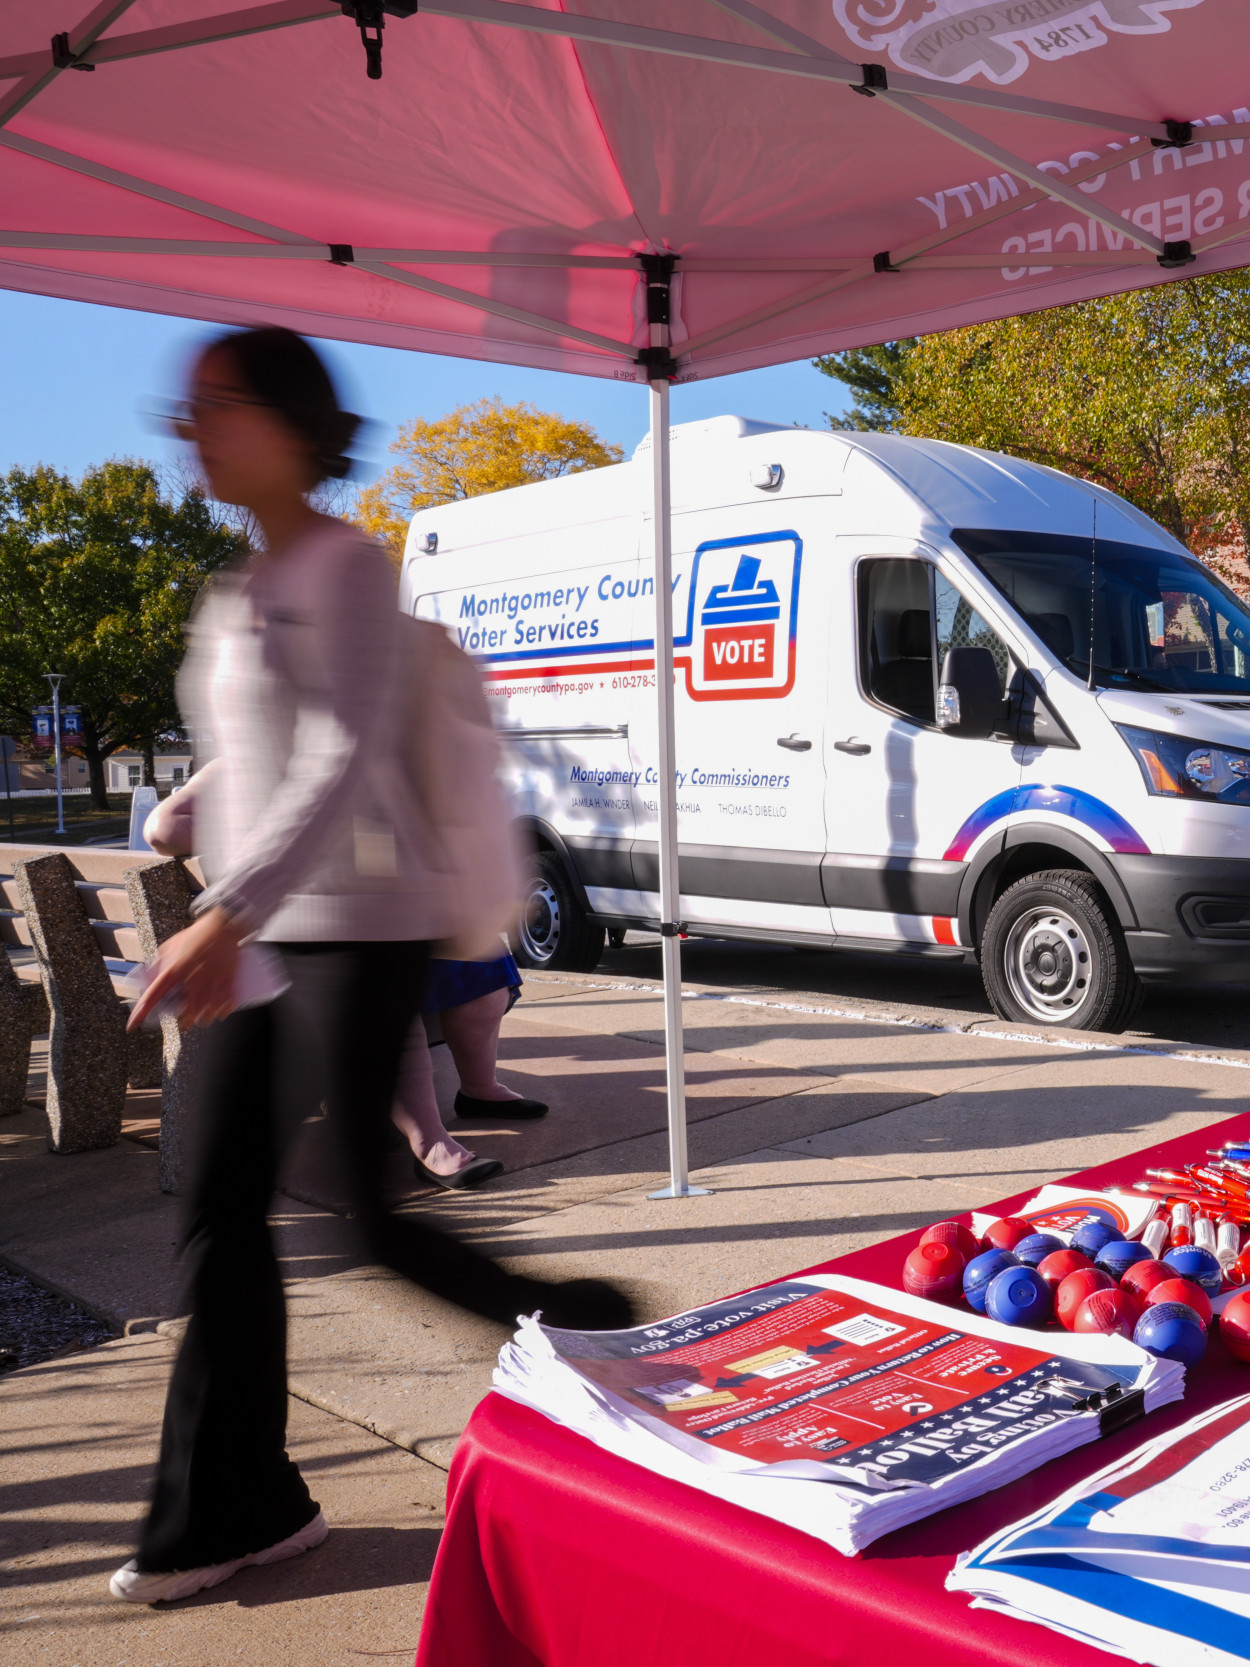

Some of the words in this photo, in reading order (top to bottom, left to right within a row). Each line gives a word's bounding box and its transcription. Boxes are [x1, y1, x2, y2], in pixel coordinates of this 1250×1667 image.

[619, 370, 635, 380] Side
[459, 584, 590, 620] Montgomery
[598, 573, 682, 600] Couny
[457, 625, 507, 650] Voter
[515, 617, 599, 645] Services
[712, 639, 765, 665] VOTE
[570, 766, 641, 788] Montgomery
[691, 768, 790, 788] Commissioners
[604, 800, 630, 810] WINDER
[676, 802, 701, 813] AKHIJA
[718, 804, 753, 816] THOMAS
[755, 806, 787, 818] DIBELLO
[1173, 1248, 1212, 1259] Montco
[750, 1292, 807, 1312] Visit
[630, 1311, 754, 1354] vote.pa.gov
[938, 1332, 960, 1342] How
[918, 1344, 933, 1352] to
[881, 1351, 920, 1371] Return
[937, 1354, 986, 1377] Private
[957, 1354, 1001, 1376] Secure
[789, 1368, 821, 1383] Election
[814, 1362, 850, 1378] Envelope
[847, 1368, 881, 1382] Your
[783, 1375, 813, 1390] Marked
[811, 1373, 838, 1384] Yellow
[779, 1379, 849, 1410] Completed
[869, 1392, 904, 1404] Vote
[892, 1392, 923, 1406] Easy
[713, 1395, 774, 1419] Pre-Addressed
[748, 1405, 780, 1422] Mail
[702, 1416, 748, 1435] Ballot
[776, 1425, 816, 1441] Apply
[978, 1408, 1081, 1445] Voting
[800, 1426, 837, 1442] Easy
[782, 1438, 799, 1447] to
[858, 1416, 1002, 1474] Ballot
[946, 1443, 995, 1463] by
[1216, 1498, 1248, 1517] 19401
